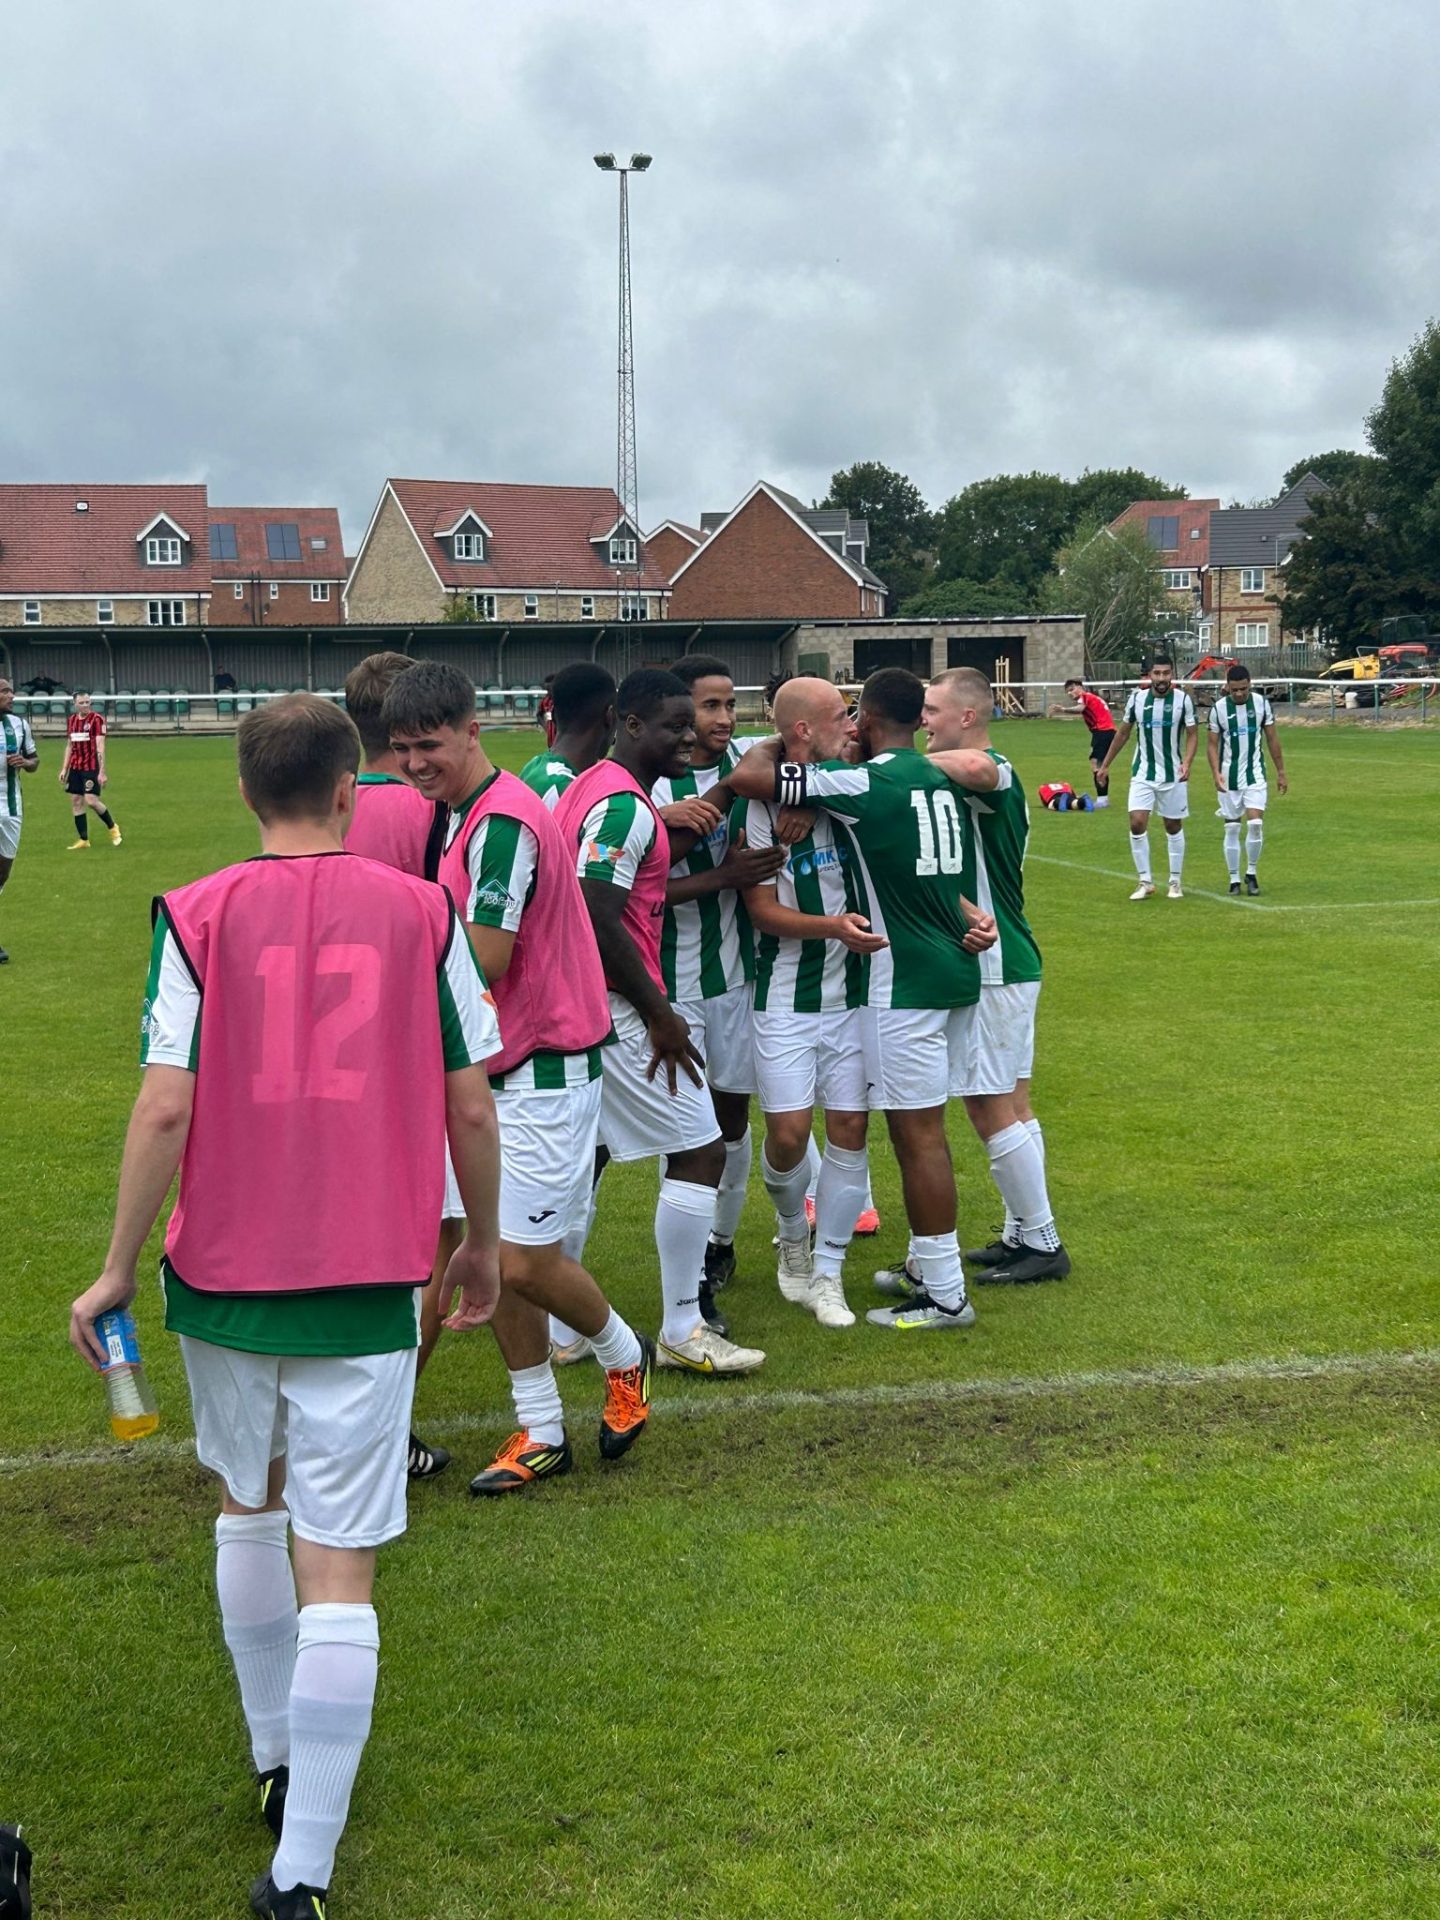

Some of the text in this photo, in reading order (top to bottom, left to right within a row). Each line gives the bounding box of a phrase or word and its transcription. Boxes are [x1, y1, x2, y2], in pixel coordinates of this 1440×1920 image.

[780, 763, 802, 778] C
[910, 789, 963, 876] 10
[253, 943, 382, 1103] 12
